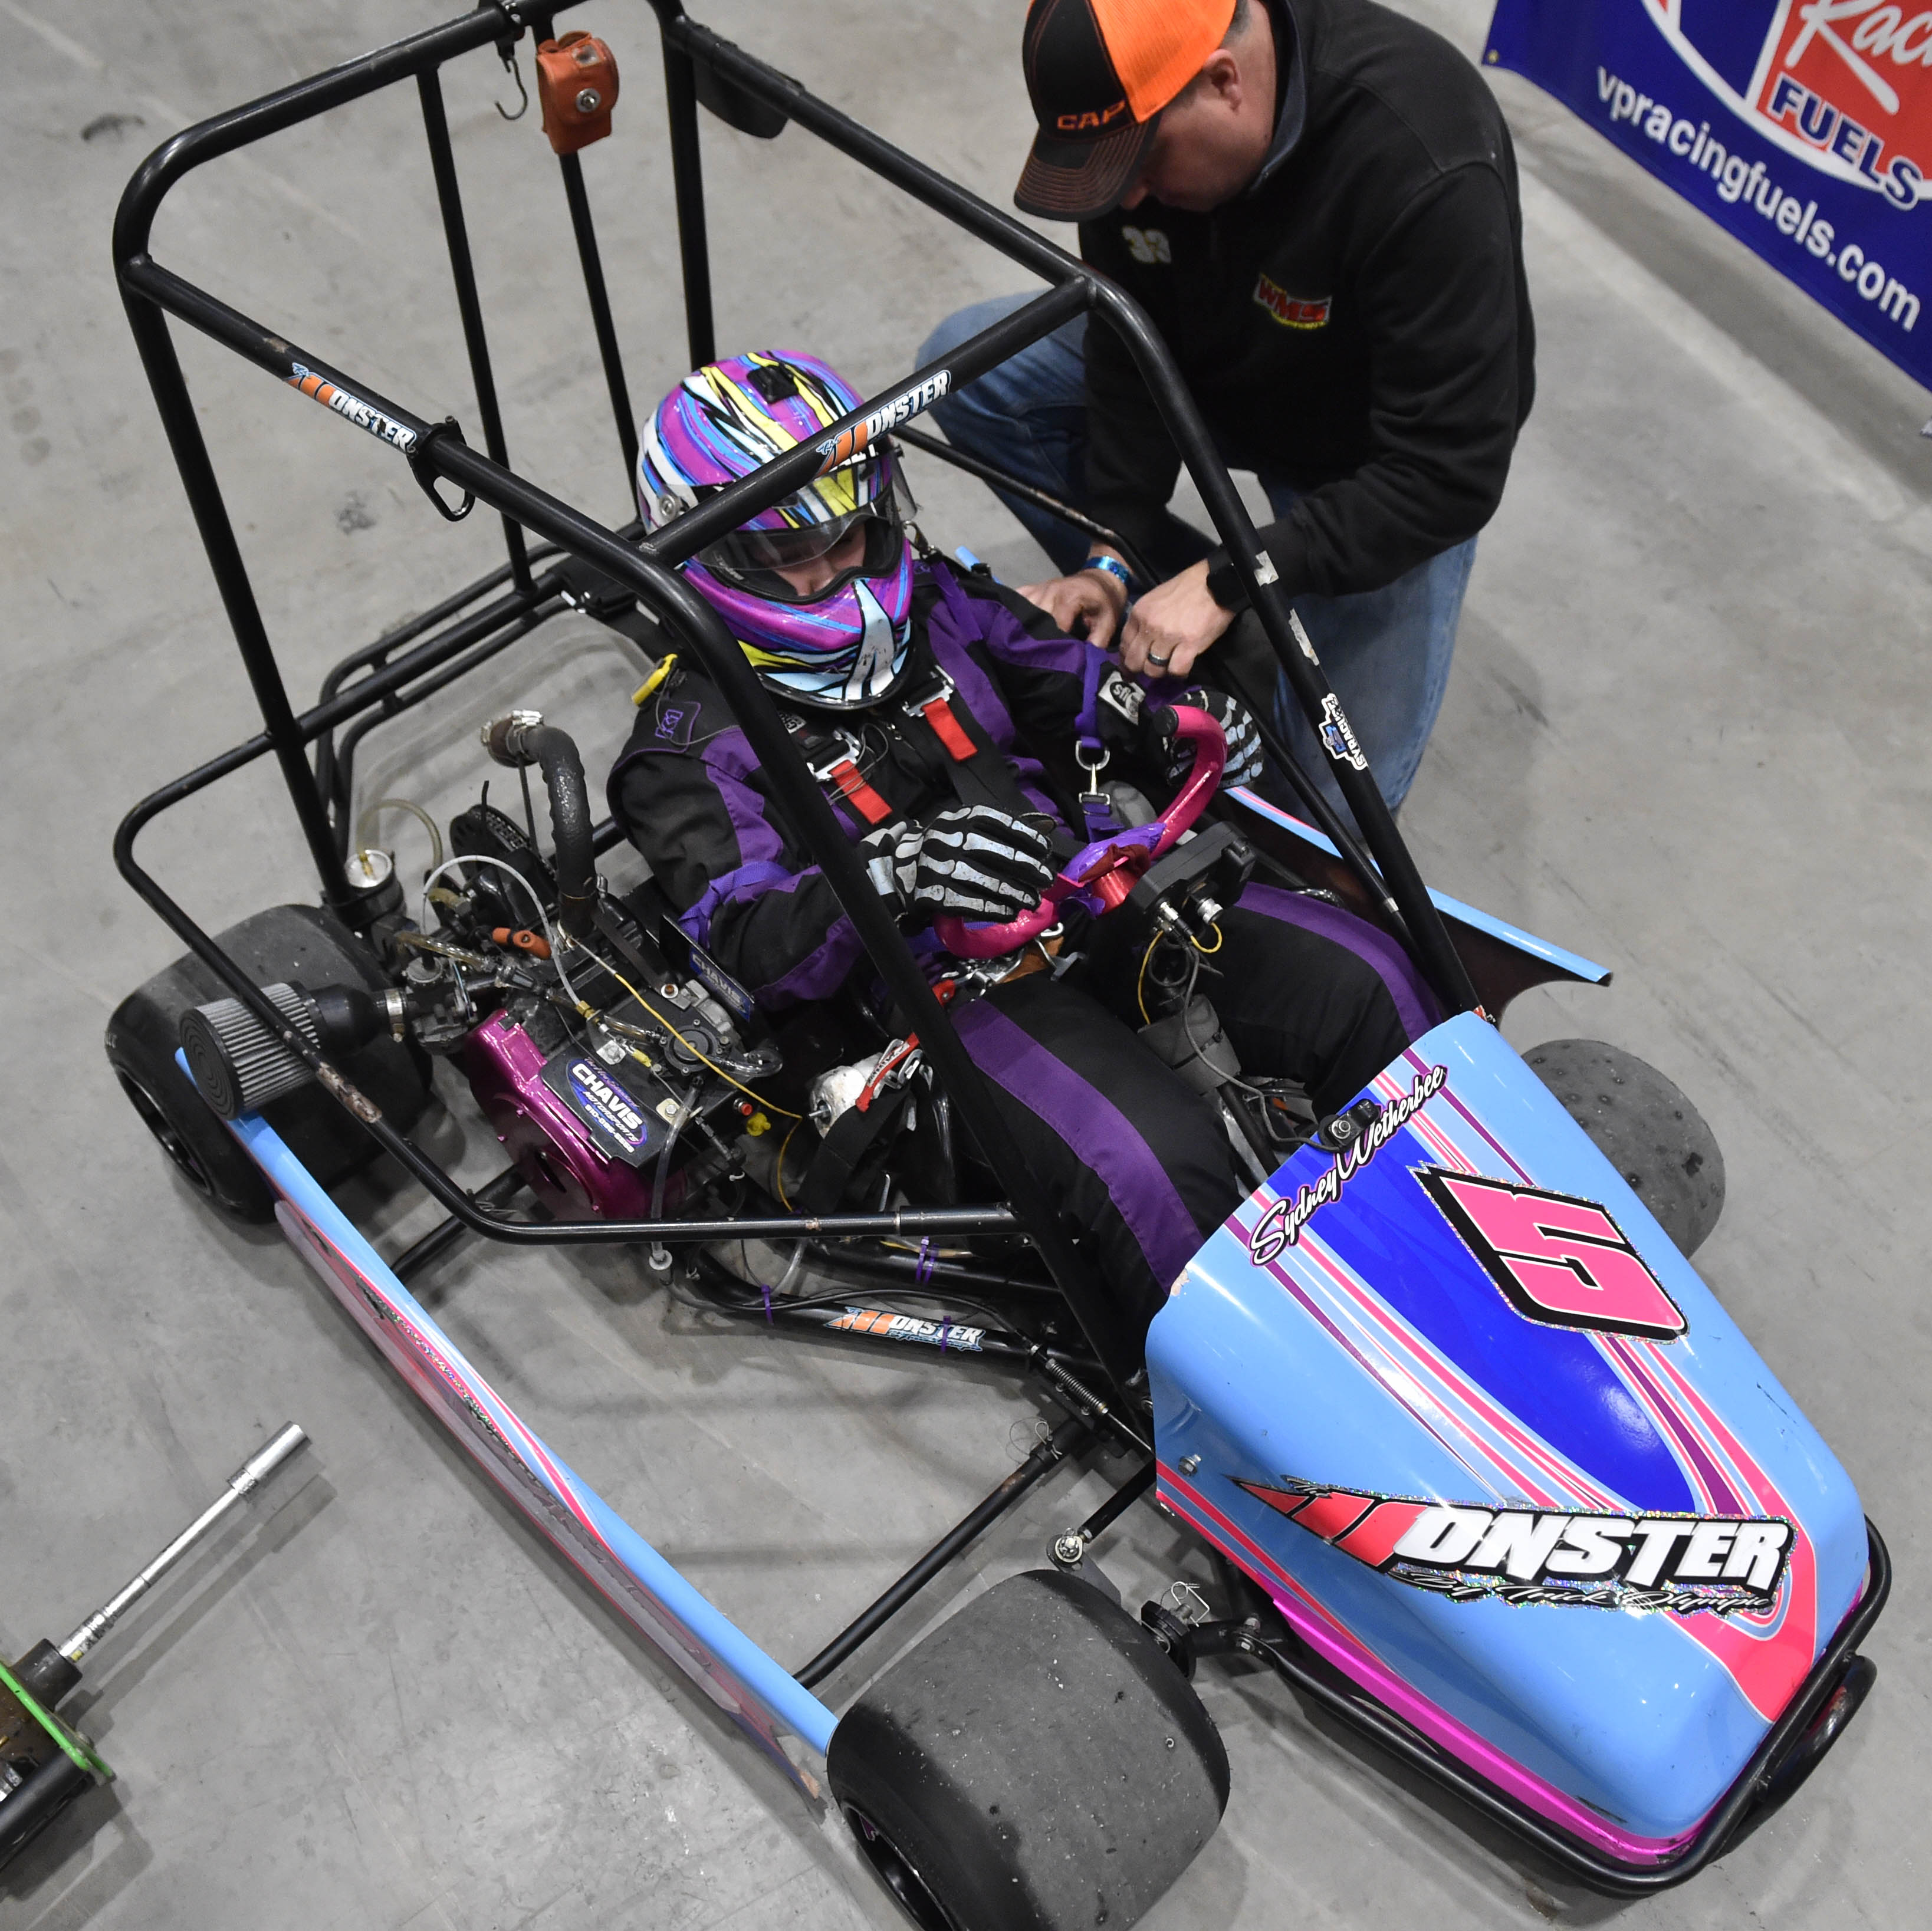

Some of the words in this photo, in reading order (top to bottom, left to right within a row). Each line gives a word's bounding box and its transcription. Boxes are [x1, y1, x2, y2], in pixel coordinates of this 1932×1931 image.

[1783, 0, 1932, 115] Rac
[1596, 65, 1921, 332] vpracingfuels.com
[1770, 71, 1923, 210] FUELS
[692, 953, 743, 1005] CHAVIS
[572, 1063, 643, 1129] CHAVIS
[583, 1091, 639, 1142] MOTORSPORTS
[1251, 1171, 1340, 1266] Sydney
[1335, 1065, 1448, 1179] Wetherbee
[1430, 1173, 1688, 1337] 5
